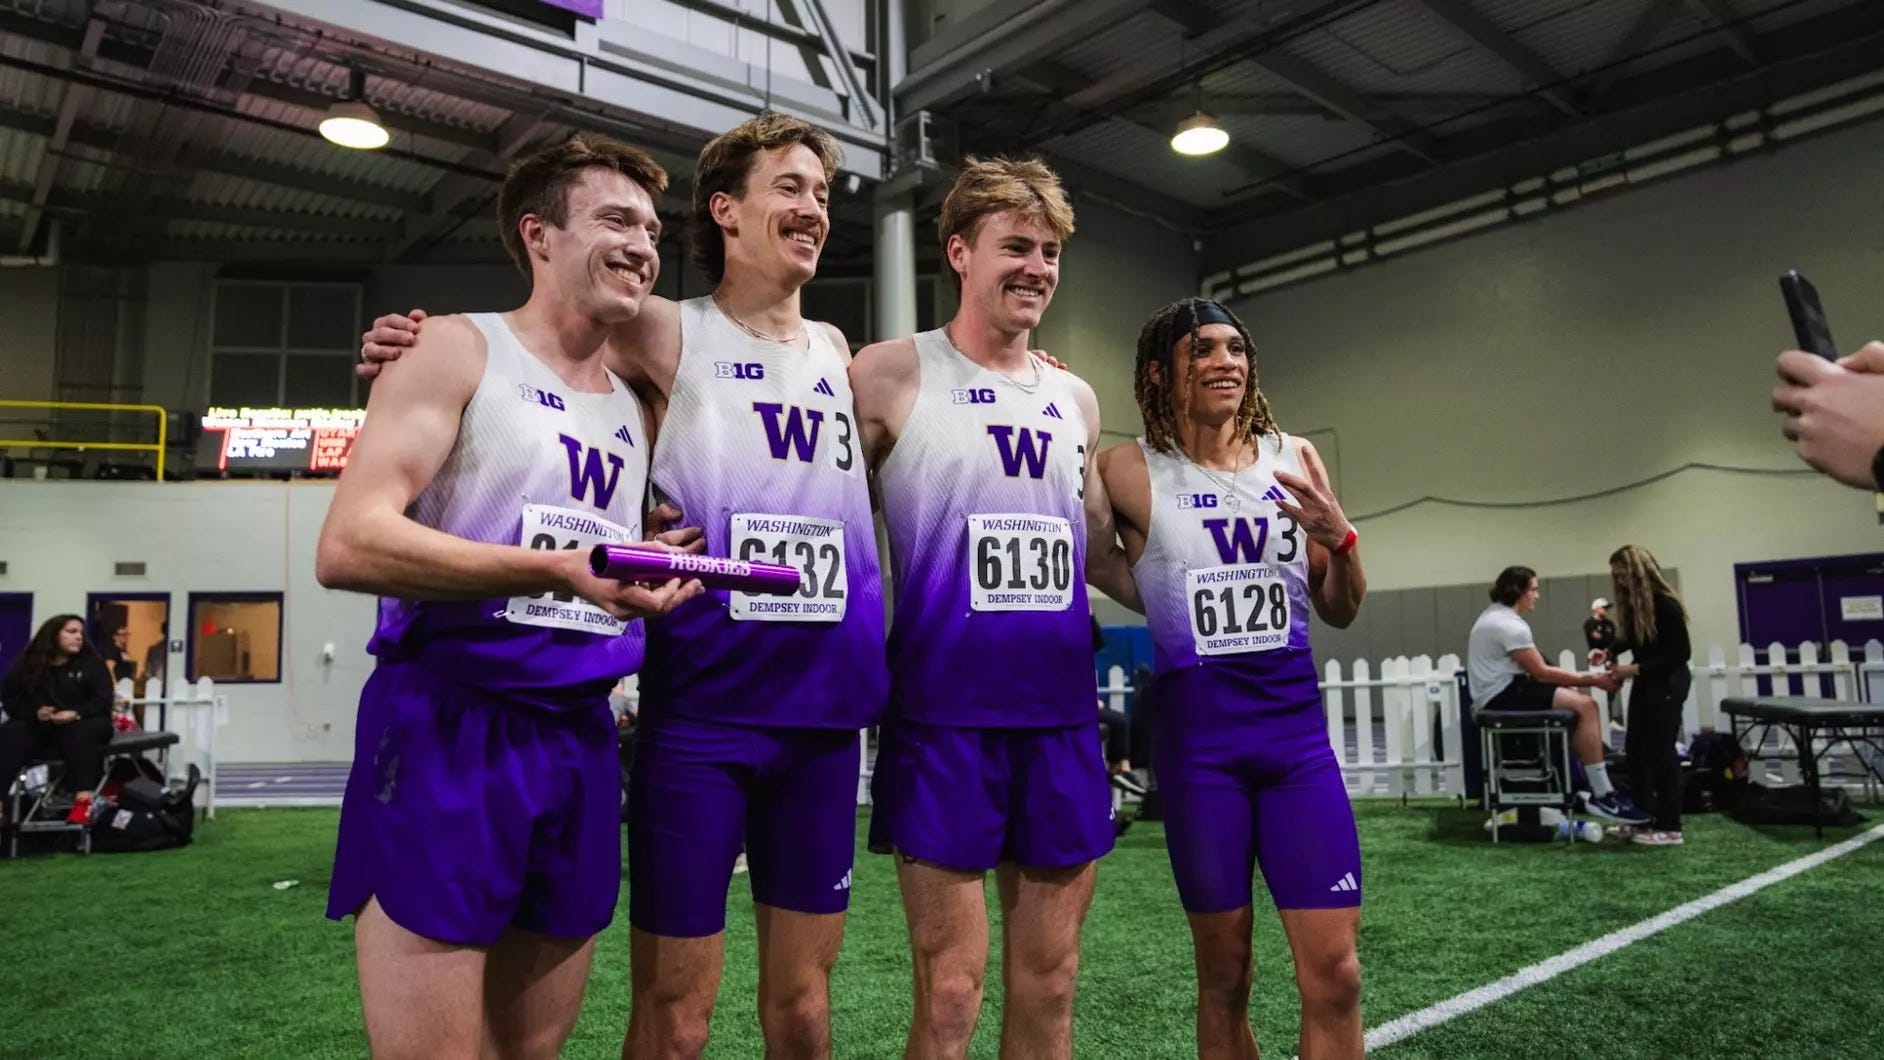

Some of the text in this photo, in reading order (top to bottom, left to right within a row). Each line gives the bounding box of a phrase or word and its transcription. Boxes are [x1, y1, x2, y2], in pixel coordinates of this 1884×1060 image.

[753, 401, 824, 463] W
[835, 412, 852, 471] 3
[987, 424, 1052, 479] W
[559, 433, 624, 510] W
[747, 518, 834, 537] WASHINGTON
[982, 519, 1062, 533] WASHINGTON
[1203, 517, 1269, 564] W
[1277, 511, 1298, 562] 3
[977, 536, 1070, 591] 6130
[1197, 567, 1276, 584] WASHINGTO
[526, 604, 581, 621] DEMPSEY
[749, 602, 838, 613] DEMPSEY INDOOR
[988, 594, 1063, 604] DEMPSEY INDOOR
[1194, 583, 1288, 637] 6128
[1207, 634, 1282, 649] DEMPSEY INDOOR
